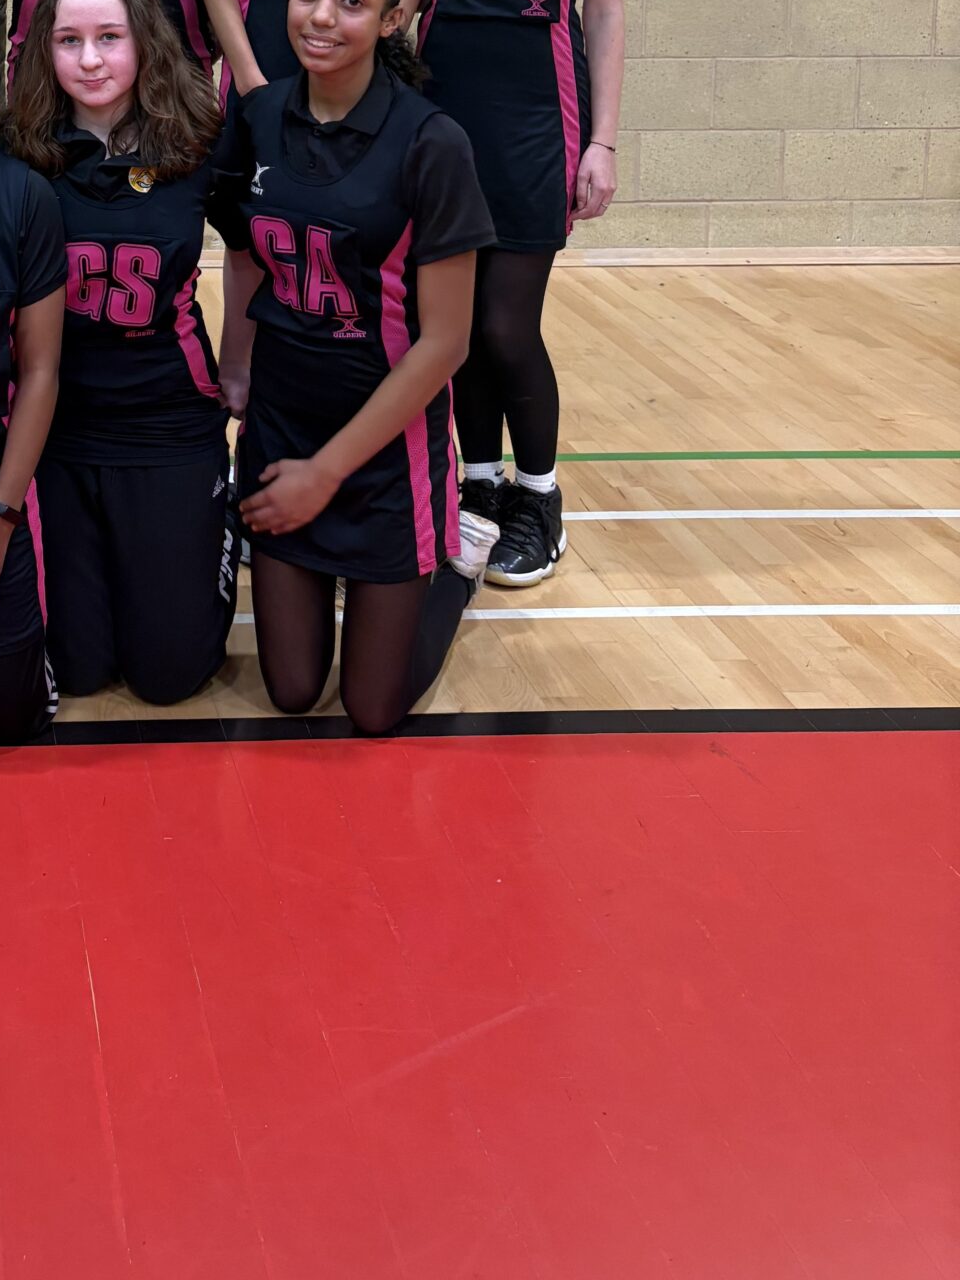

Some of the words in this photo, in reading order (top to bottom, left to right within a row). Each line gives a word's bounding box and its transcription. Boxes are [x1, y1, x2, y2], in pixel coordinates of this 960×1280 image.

[65, 241, 162, 327] GS
[250, 214, 359, 317] GA
[332, 331, 367, 339] GILBERT
